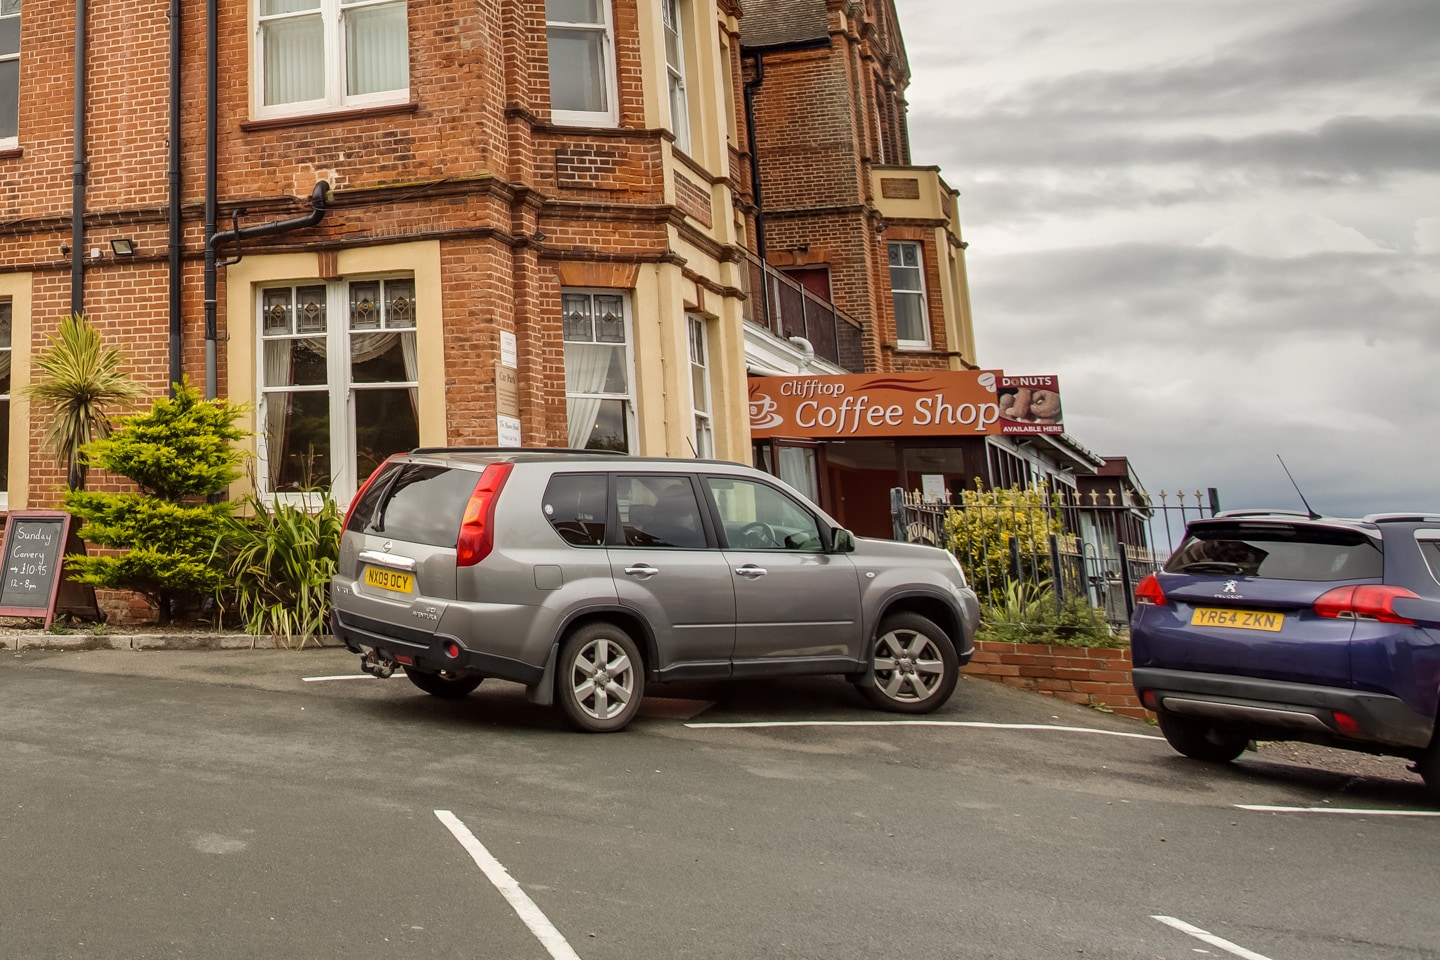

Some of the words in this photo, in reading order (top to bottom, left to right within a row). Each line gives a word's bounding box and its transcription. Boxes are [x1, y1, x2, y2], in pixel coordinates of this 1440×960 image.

[780, 379, 845, 399] Clifftop
[1002, 376, 1052, 386] DONUTS
[795, 395, 904, 433] Coffee
[913, 393, 1000, 431] Shop
[17, 527, 51, 546] Sunday
[13, 545, 45, 565] Carvery
[368, 569, 389, 586] NX09
[1199, 610, 1237, 624] YR64
[1242, 613, 1276, 628] ZKN
